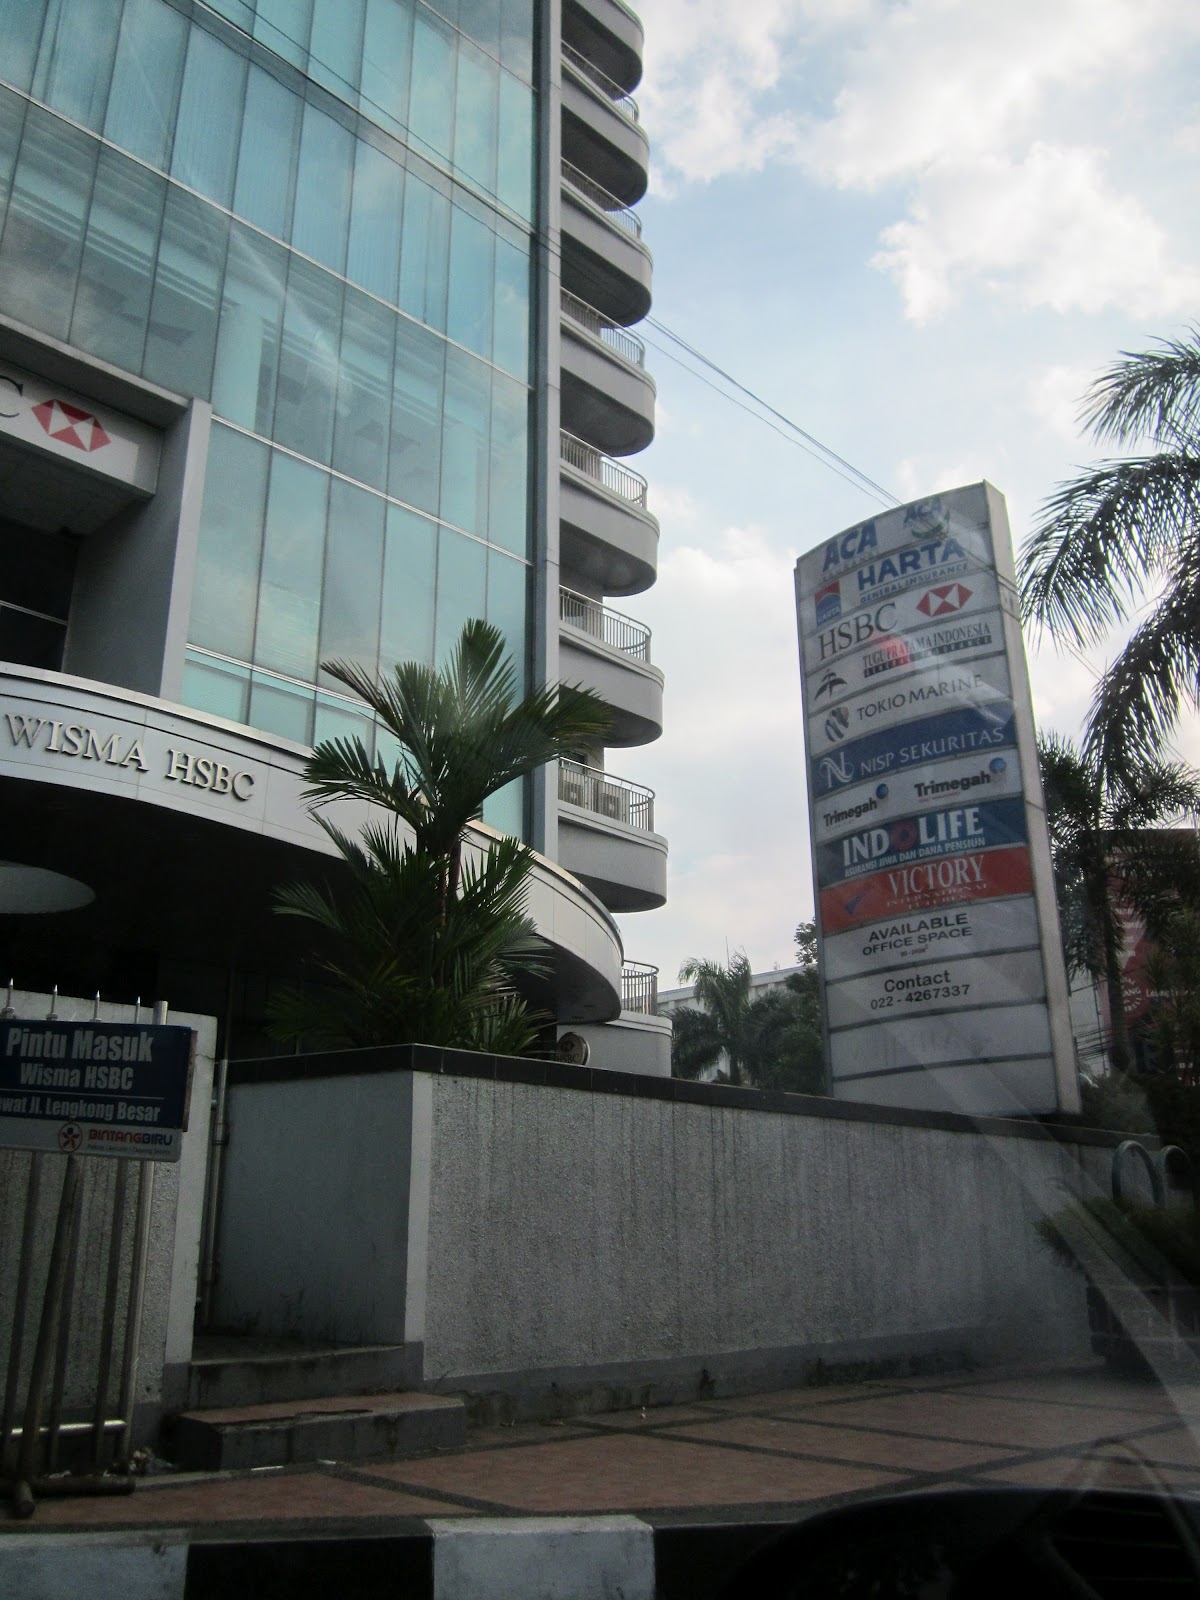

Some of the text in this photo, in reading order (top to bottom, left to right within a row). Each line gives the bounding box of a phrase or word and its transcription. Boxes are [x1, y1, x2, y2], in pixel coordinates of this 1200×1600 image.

[823, 521, 878, 572] ACA
[858, 538, 966, 591] HARTA
[818, 601, 898, 660] HSBC
[933, 622, 991, 647] INDONESIA
[5, 713, 255, 802] WISMA HSBC
[860, 727, 1004, 776] NISP SEKURITAS
[914, 771, 991, 798] Trimegah
[823, 798, 878, 827] Trimegah
[845, 837, 986, 877] ASURANSI JIWA DAN DANA PENSIUN
[888, 855, 985, 897] VICTORY
[863, 927, 972, 956] OFFICE SPACE
[868, 913, 969, 943] AVAILABLE
[884, 970, 952, 993] Contact
[870, 996, 894, 1010] 022
[905, 984, 970, 1003] 4267337
[6, 1027, 154, 1062] Pintu Masuk
[20, 1063, 134, 1090] Wisma HSBC
[0, 1096, 27, 1113] wat
[45, 1098, 114, 1121] Lengkong
[117, 1102, 161, 1122] Besar
